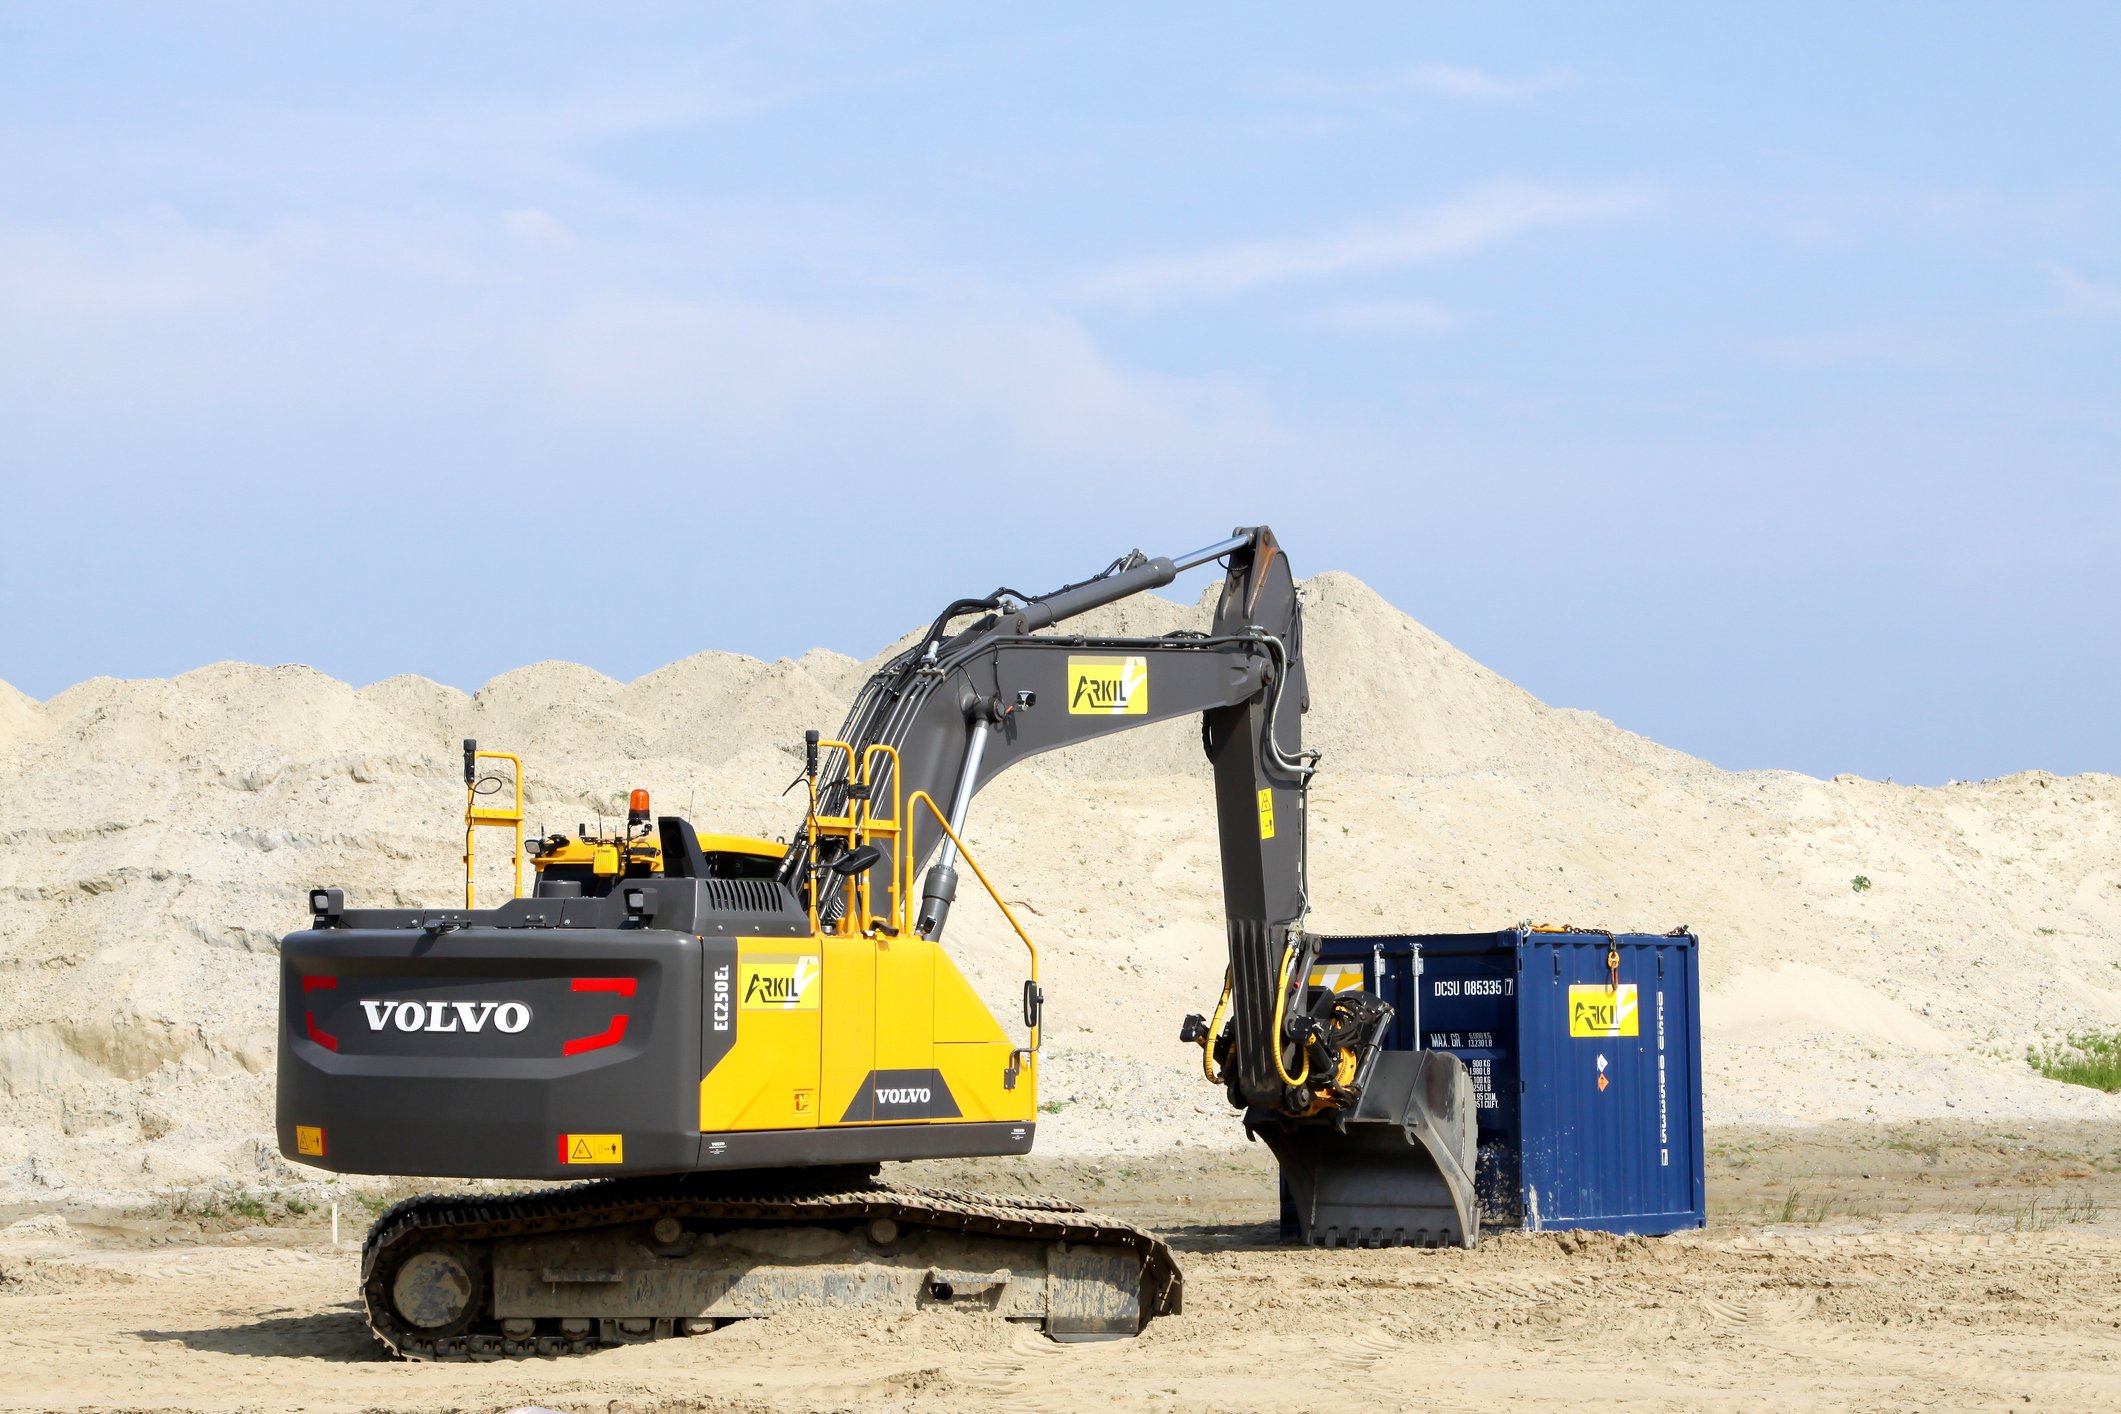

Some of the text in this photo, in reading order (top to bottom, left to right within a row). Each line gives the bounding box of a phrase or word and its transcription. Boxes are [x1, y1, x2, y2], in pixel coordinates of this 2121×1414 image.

[1072, 675, 1128, 708] ARKIL
[744, 973, 800, 1003] ARKIL
[1434, 978, 1514, 997] DCSU 085335 7
[359, 1000, 530, 1034] VOLVO
[1656, 991, 1664, 1050] DCSU
[1430, 1033, 1451, 1048] MAX.
[1472, 1060, 1491, 1068] 900 KG
[1484, 1067, 1491, 1076] LB
[1484, 1076, 1491, 1084] KG
[1484, 1084, 1491, 1092] LB
[875, 1088, 931, 1104] VOLVO
[1658, 1054, 1667, 1144] 085335
